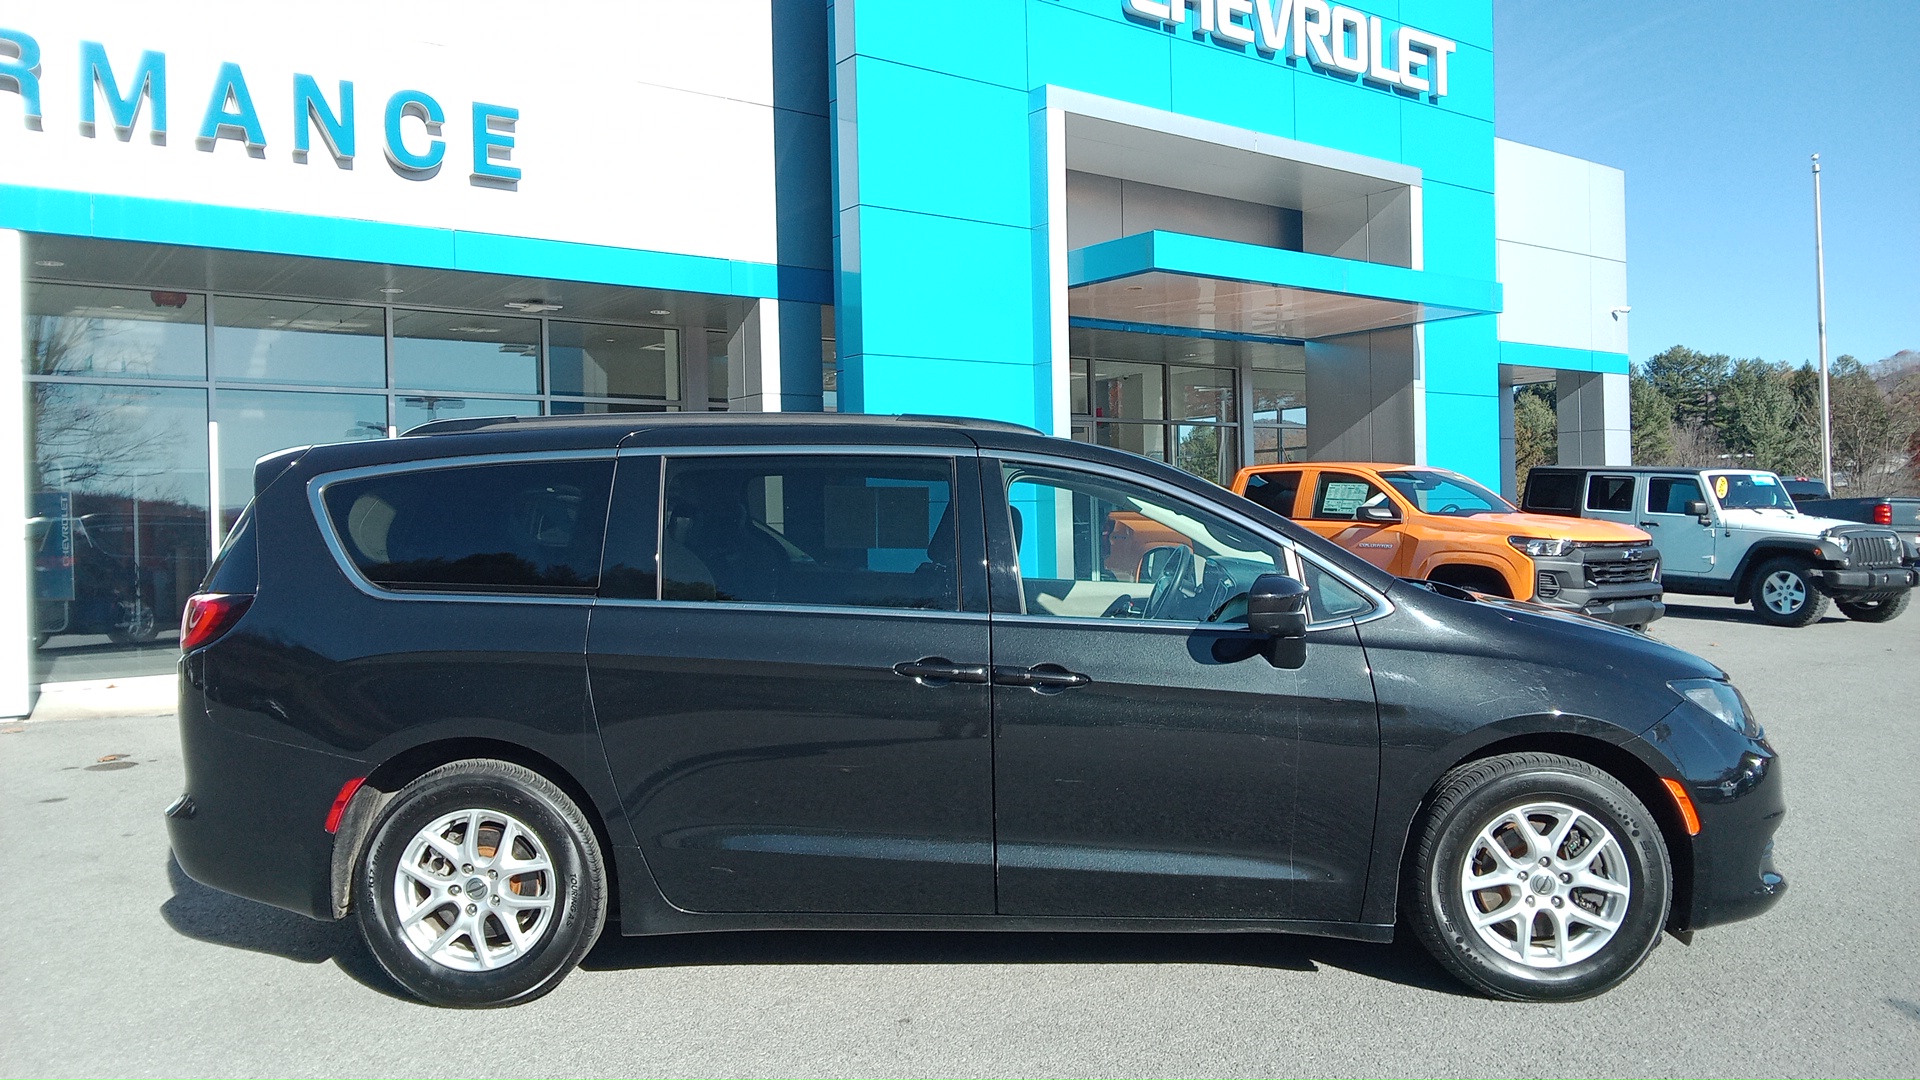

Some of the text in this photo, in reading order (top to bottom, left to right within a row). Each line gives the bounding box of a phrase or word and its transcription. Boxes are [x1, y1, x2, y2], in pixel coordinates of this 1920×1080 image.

[1122, 0, 1456, 98] EVROLET
[0, 28, 521, 190] RMANCE
[60, 496, 70, 567] CHEVROLET
[570, 873, 578, 912] TOURING
